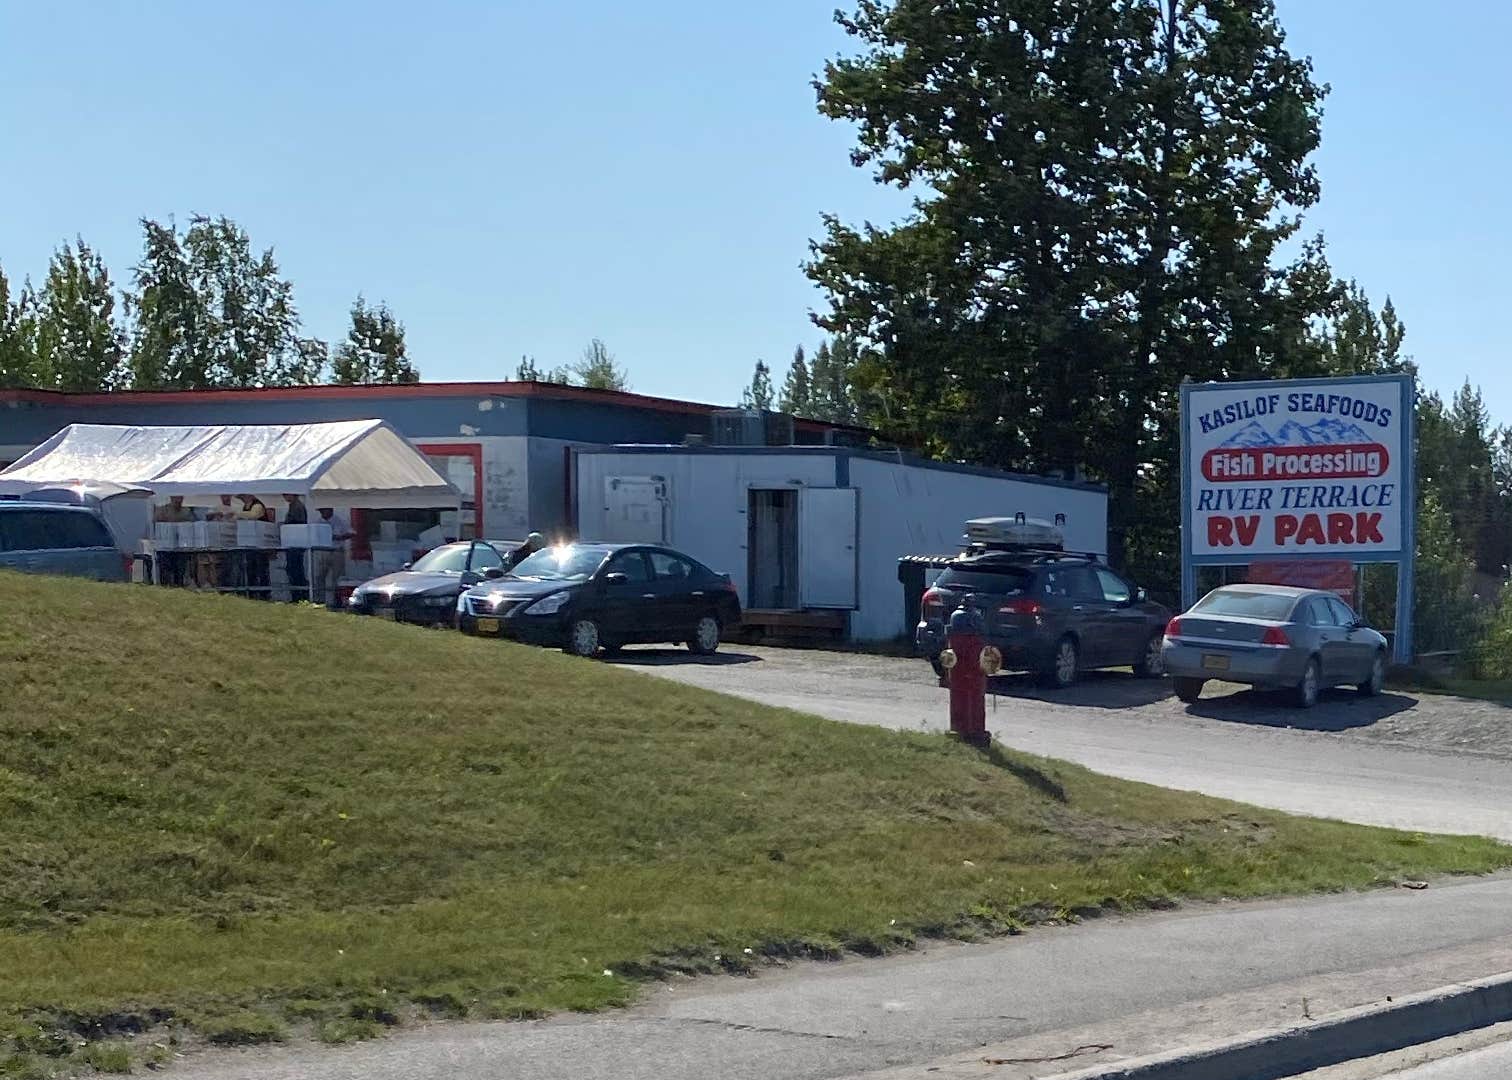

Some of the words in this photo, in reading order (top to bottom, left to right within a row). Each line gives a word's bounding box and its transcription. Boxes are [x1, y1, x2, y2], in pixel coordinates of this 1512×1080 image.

[1199, 394, 1280, 434] KASILOF
[1287, 393, 1392, 428] SEAFOODS
[1210, 454, 1256, 478] Fish
[1262, 449, 1380, 476] Processing
[1196, 487, 1273, 511] RIVER
[1280, 484, 1395, 509] TERRACE
[1207, 515, 1261, 548] RV
[1274, 512, 1384, 546] PARK
